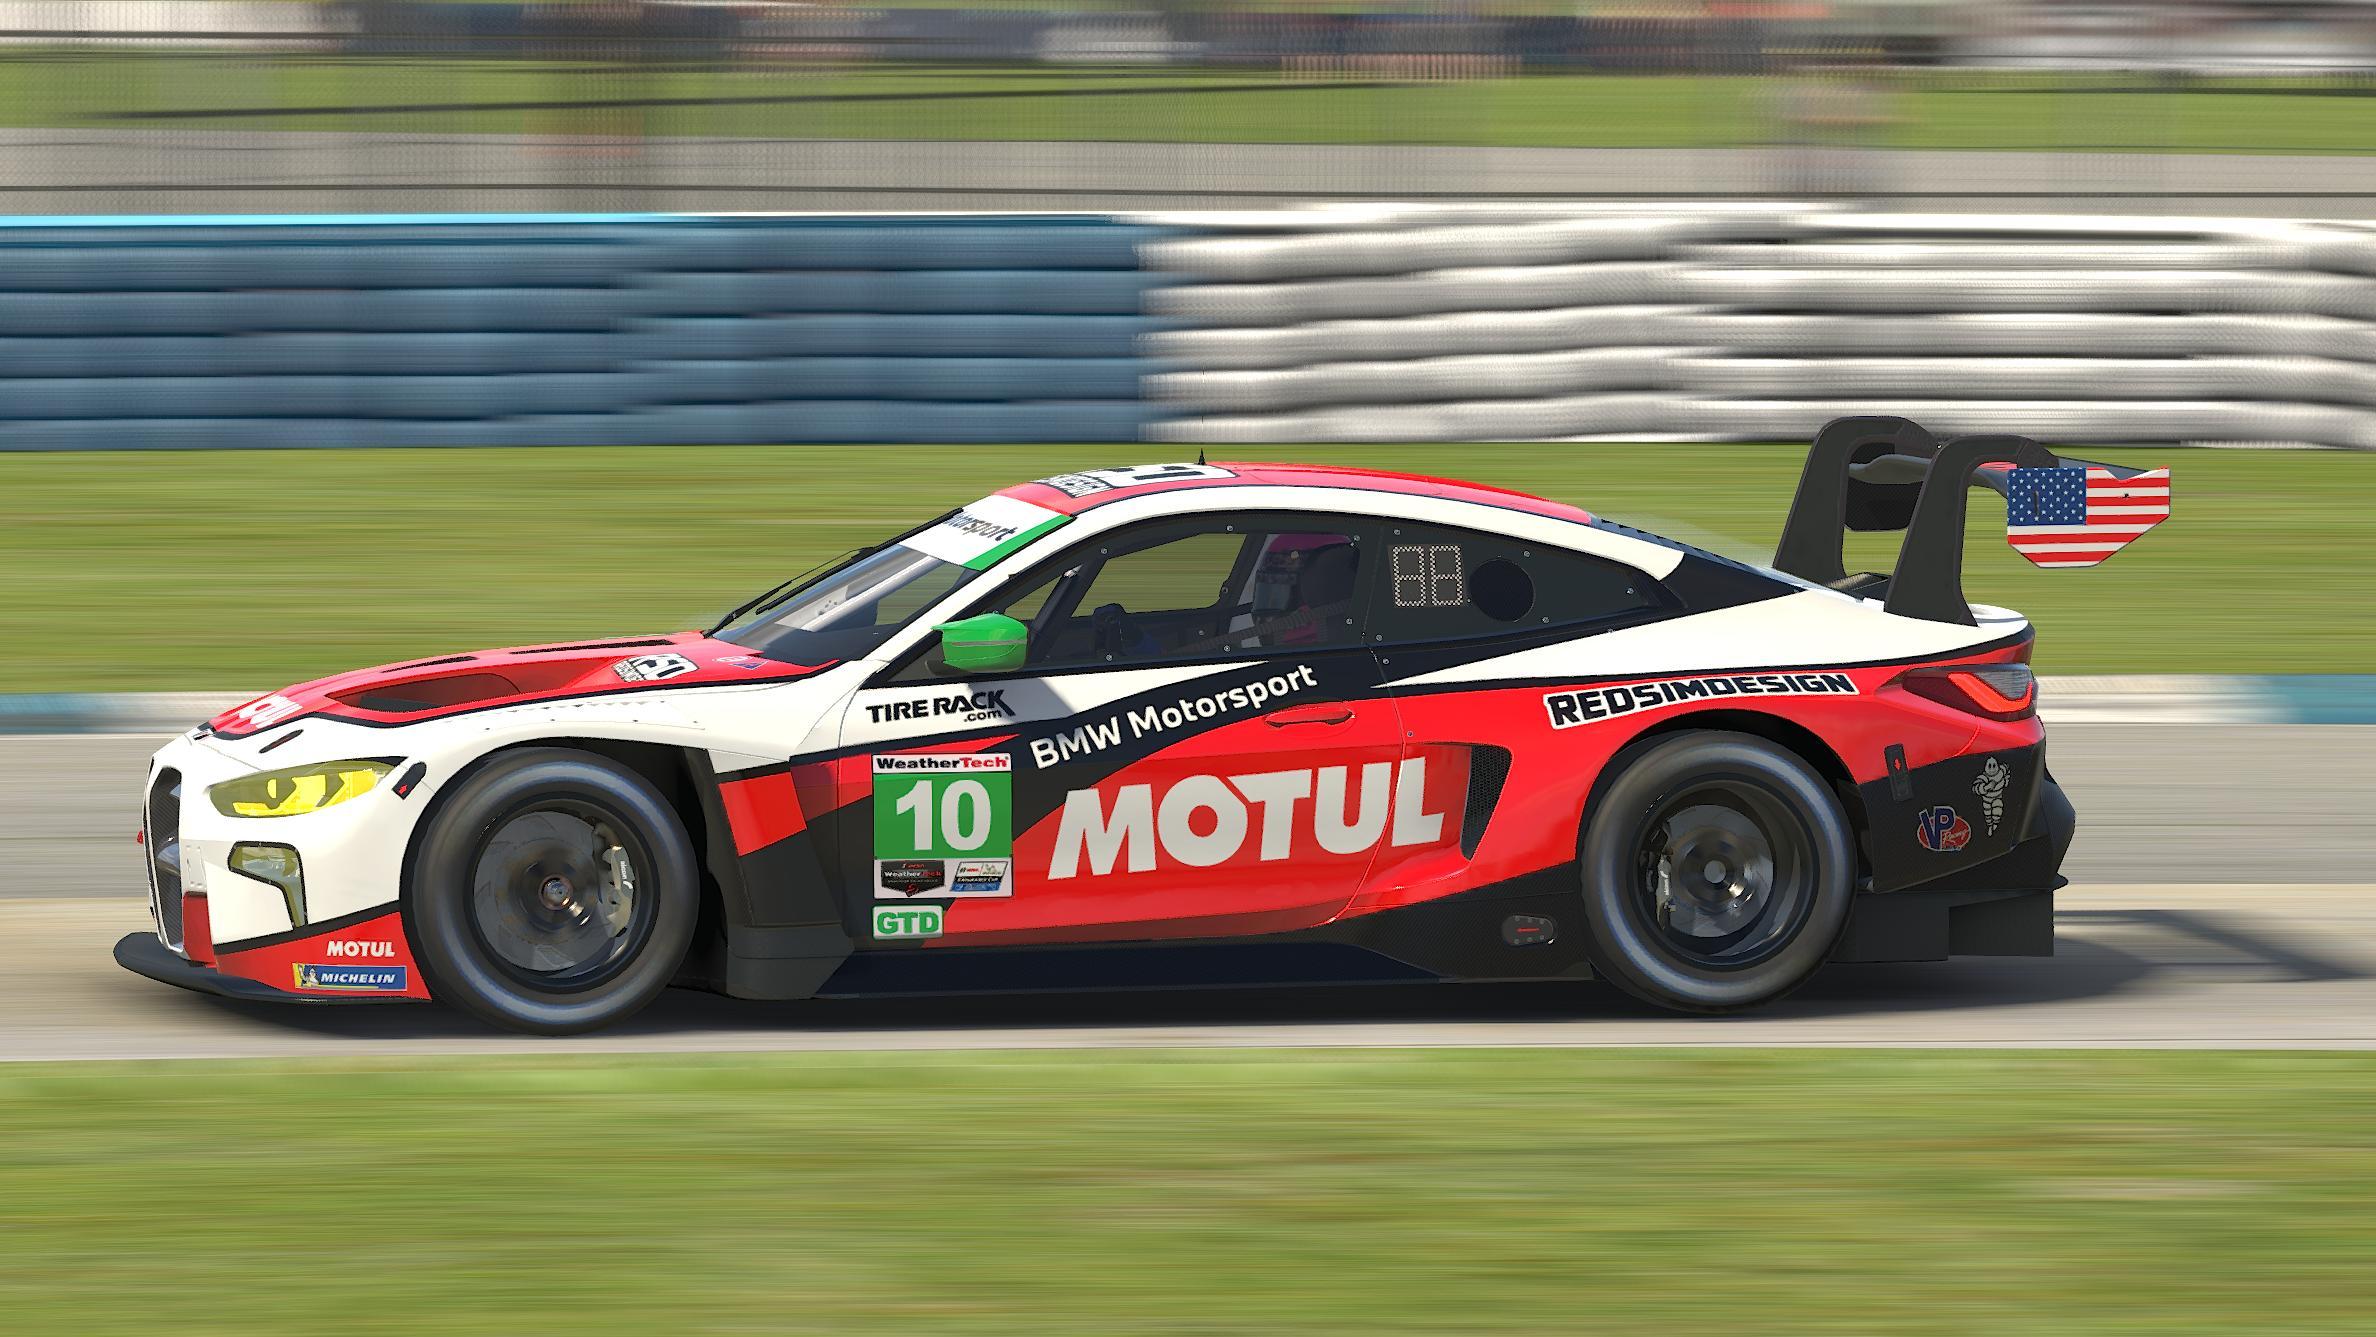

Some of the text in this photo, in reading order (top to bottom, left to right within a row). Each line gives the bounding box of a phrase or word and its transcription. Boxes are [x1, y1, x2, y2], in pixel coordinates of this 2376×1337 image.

[866, 689, 1016, 723] TIRE RACK
[963, 709, 1002, 722] .com
[1547, 673, 1856, 726] REDSIMDESIGN
[1029, 664, 1318, 770] BMW Motorsport
[876, 757, 1008, 769] WeatherTech
[896, 779, 991, 850] 10
[1047, 756, 1445, 880] MOTUL
[1919, 806, 1956, 851] VP
[877, 911, 939, 935] GTD
[326, 940, 395, 957] MOTUL
[320, 972, 395, 984] MICHELIN
